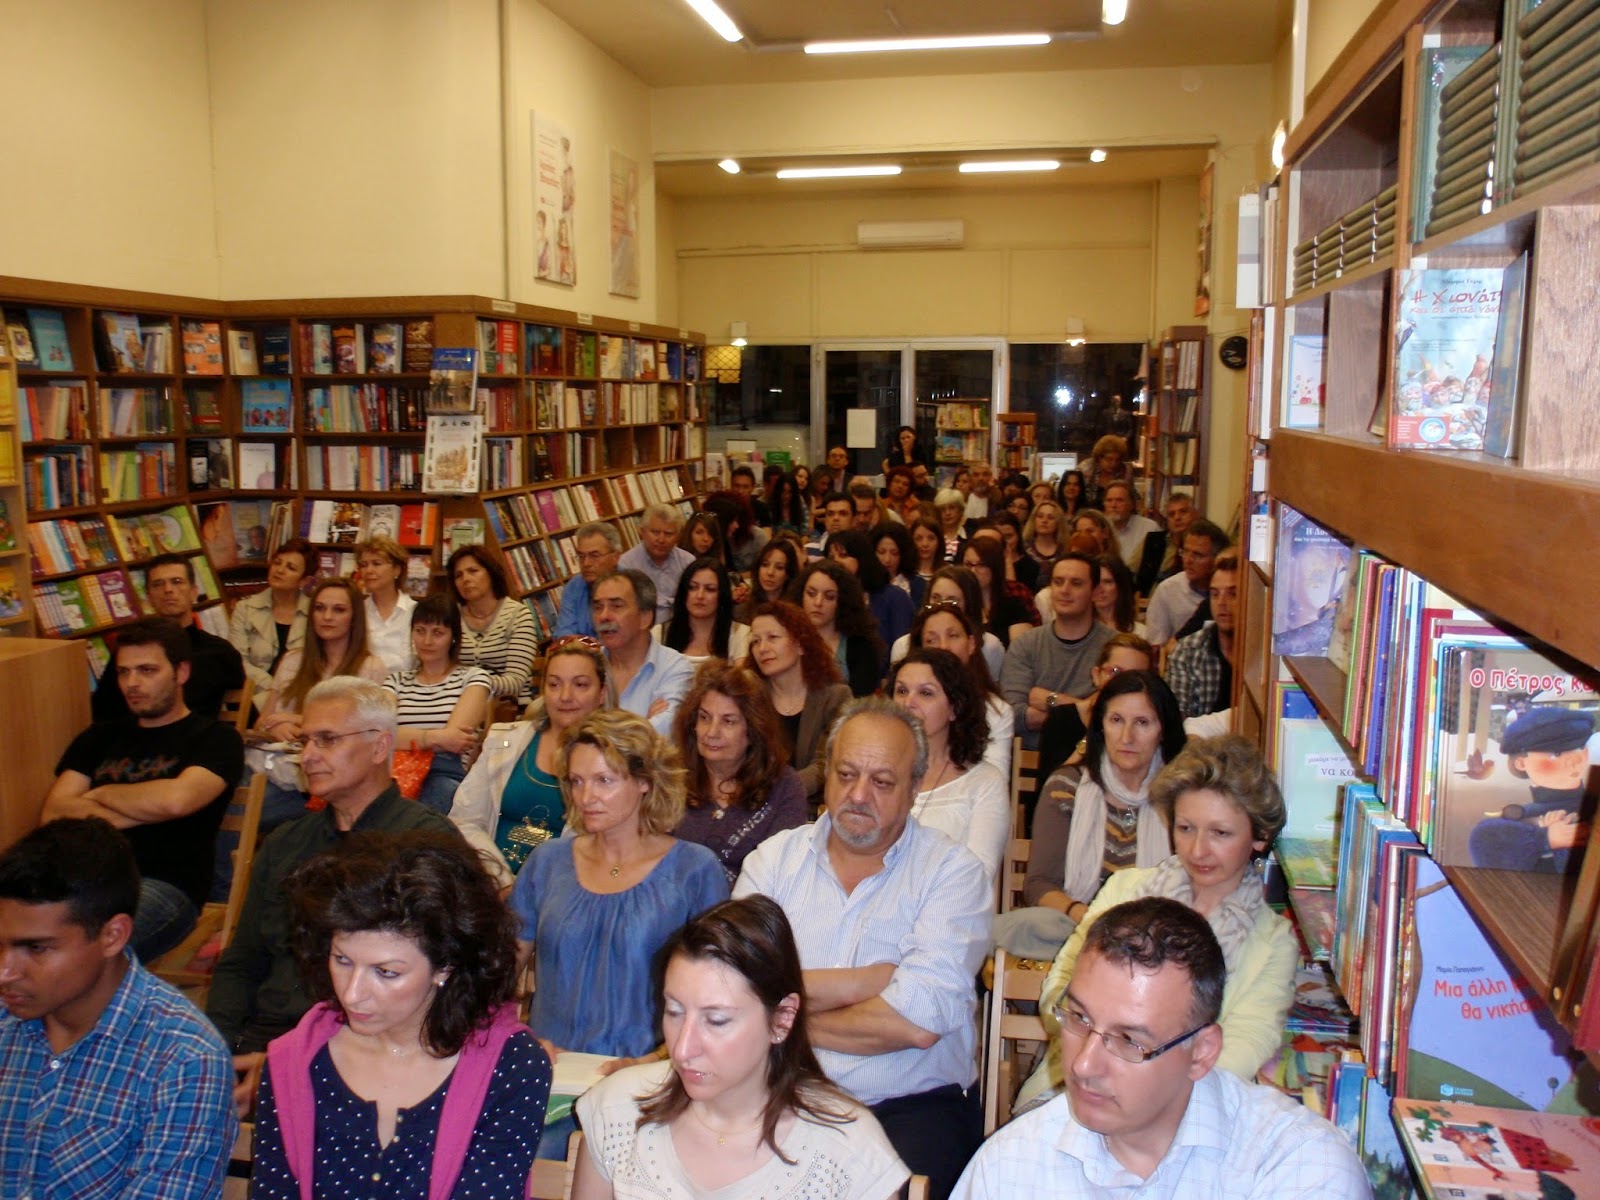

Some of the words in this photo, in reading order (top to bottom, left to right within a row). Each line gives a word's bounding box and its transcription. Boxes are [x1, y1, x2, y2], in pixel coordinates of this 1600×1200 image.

[1469, 668, 1486, 688] Ο
[1490, 667, 1565, 696] Πέτρος
[1570, 676, 1594, 693] κα
[1321, 768, 1336, 776] να
[1340, 768, 1355, 777] κο
[1434, 980, 1463, 997] Μια
[1467, 977, 1507, 997] άλλη
[1461, 1002, 1482, 1020] θα
[1486, 998, 1532, 1019] νικήσ
